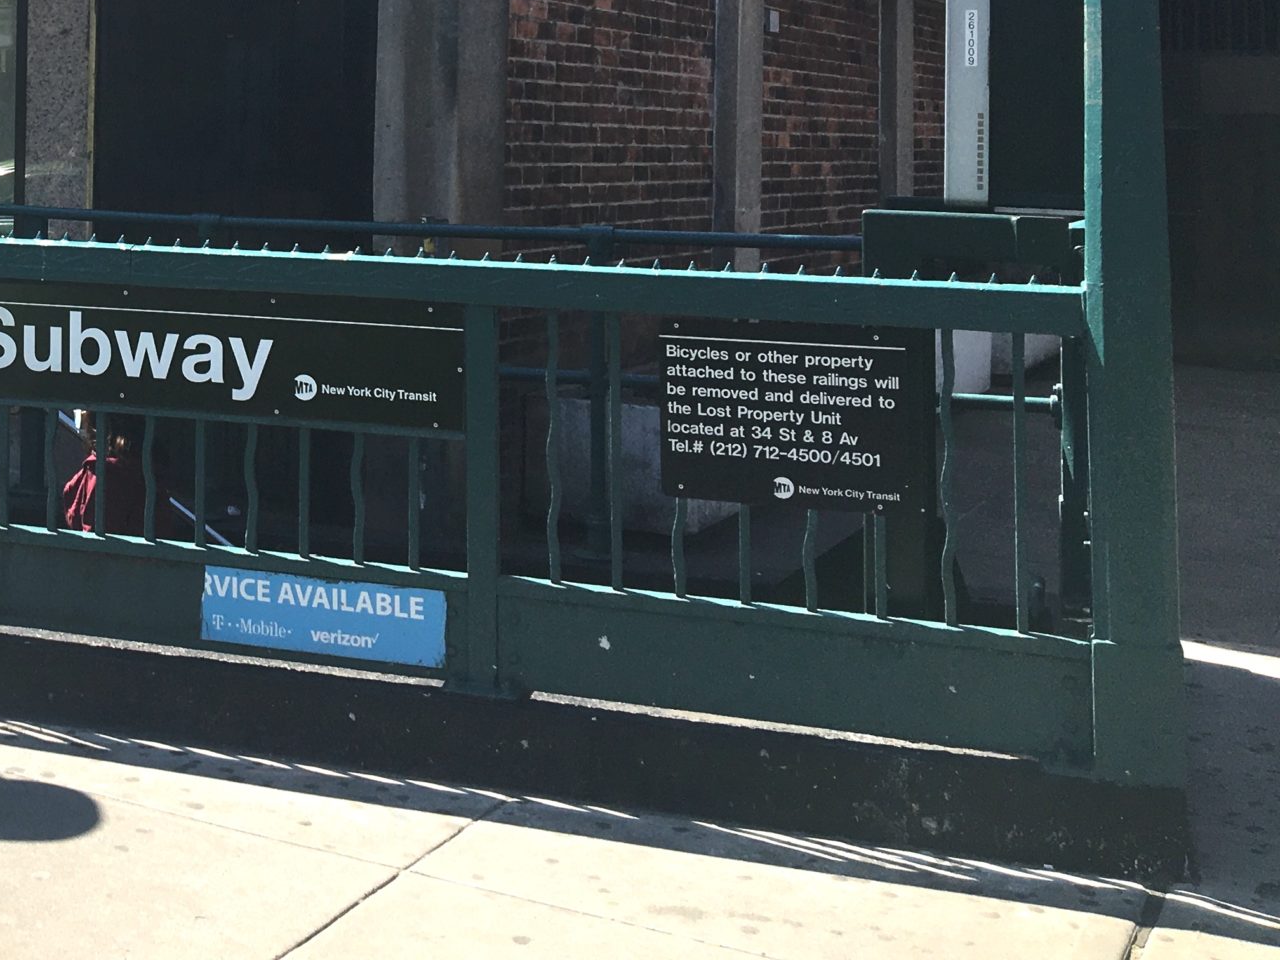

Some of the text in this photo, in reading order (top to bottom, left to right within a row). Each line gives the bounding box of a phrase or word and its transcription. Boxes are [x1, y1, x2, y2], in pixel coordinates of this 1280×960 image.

[967, 11, 975, 66] 261009
[665, 344, 874, 371] Bicycles or other property
[294, 377, 437, 403] MTA New York City Transit
[666, 365, 900, 390] attached to these railings will
[666, 382, 896, 410] be removed and delivered to
[667, 401, 842, 426] the Lost Property Unit
[667, 420, 859, 446] located at 34 St & 8 Av
[667, 439, 881, 467] Tel.# (212) 712-4500/4501
[773, 479, 901, 502] MTA New York City Transit
[277, 583, 425, 620] AVAILABLE
[310, 629, 372, 649] verizon
